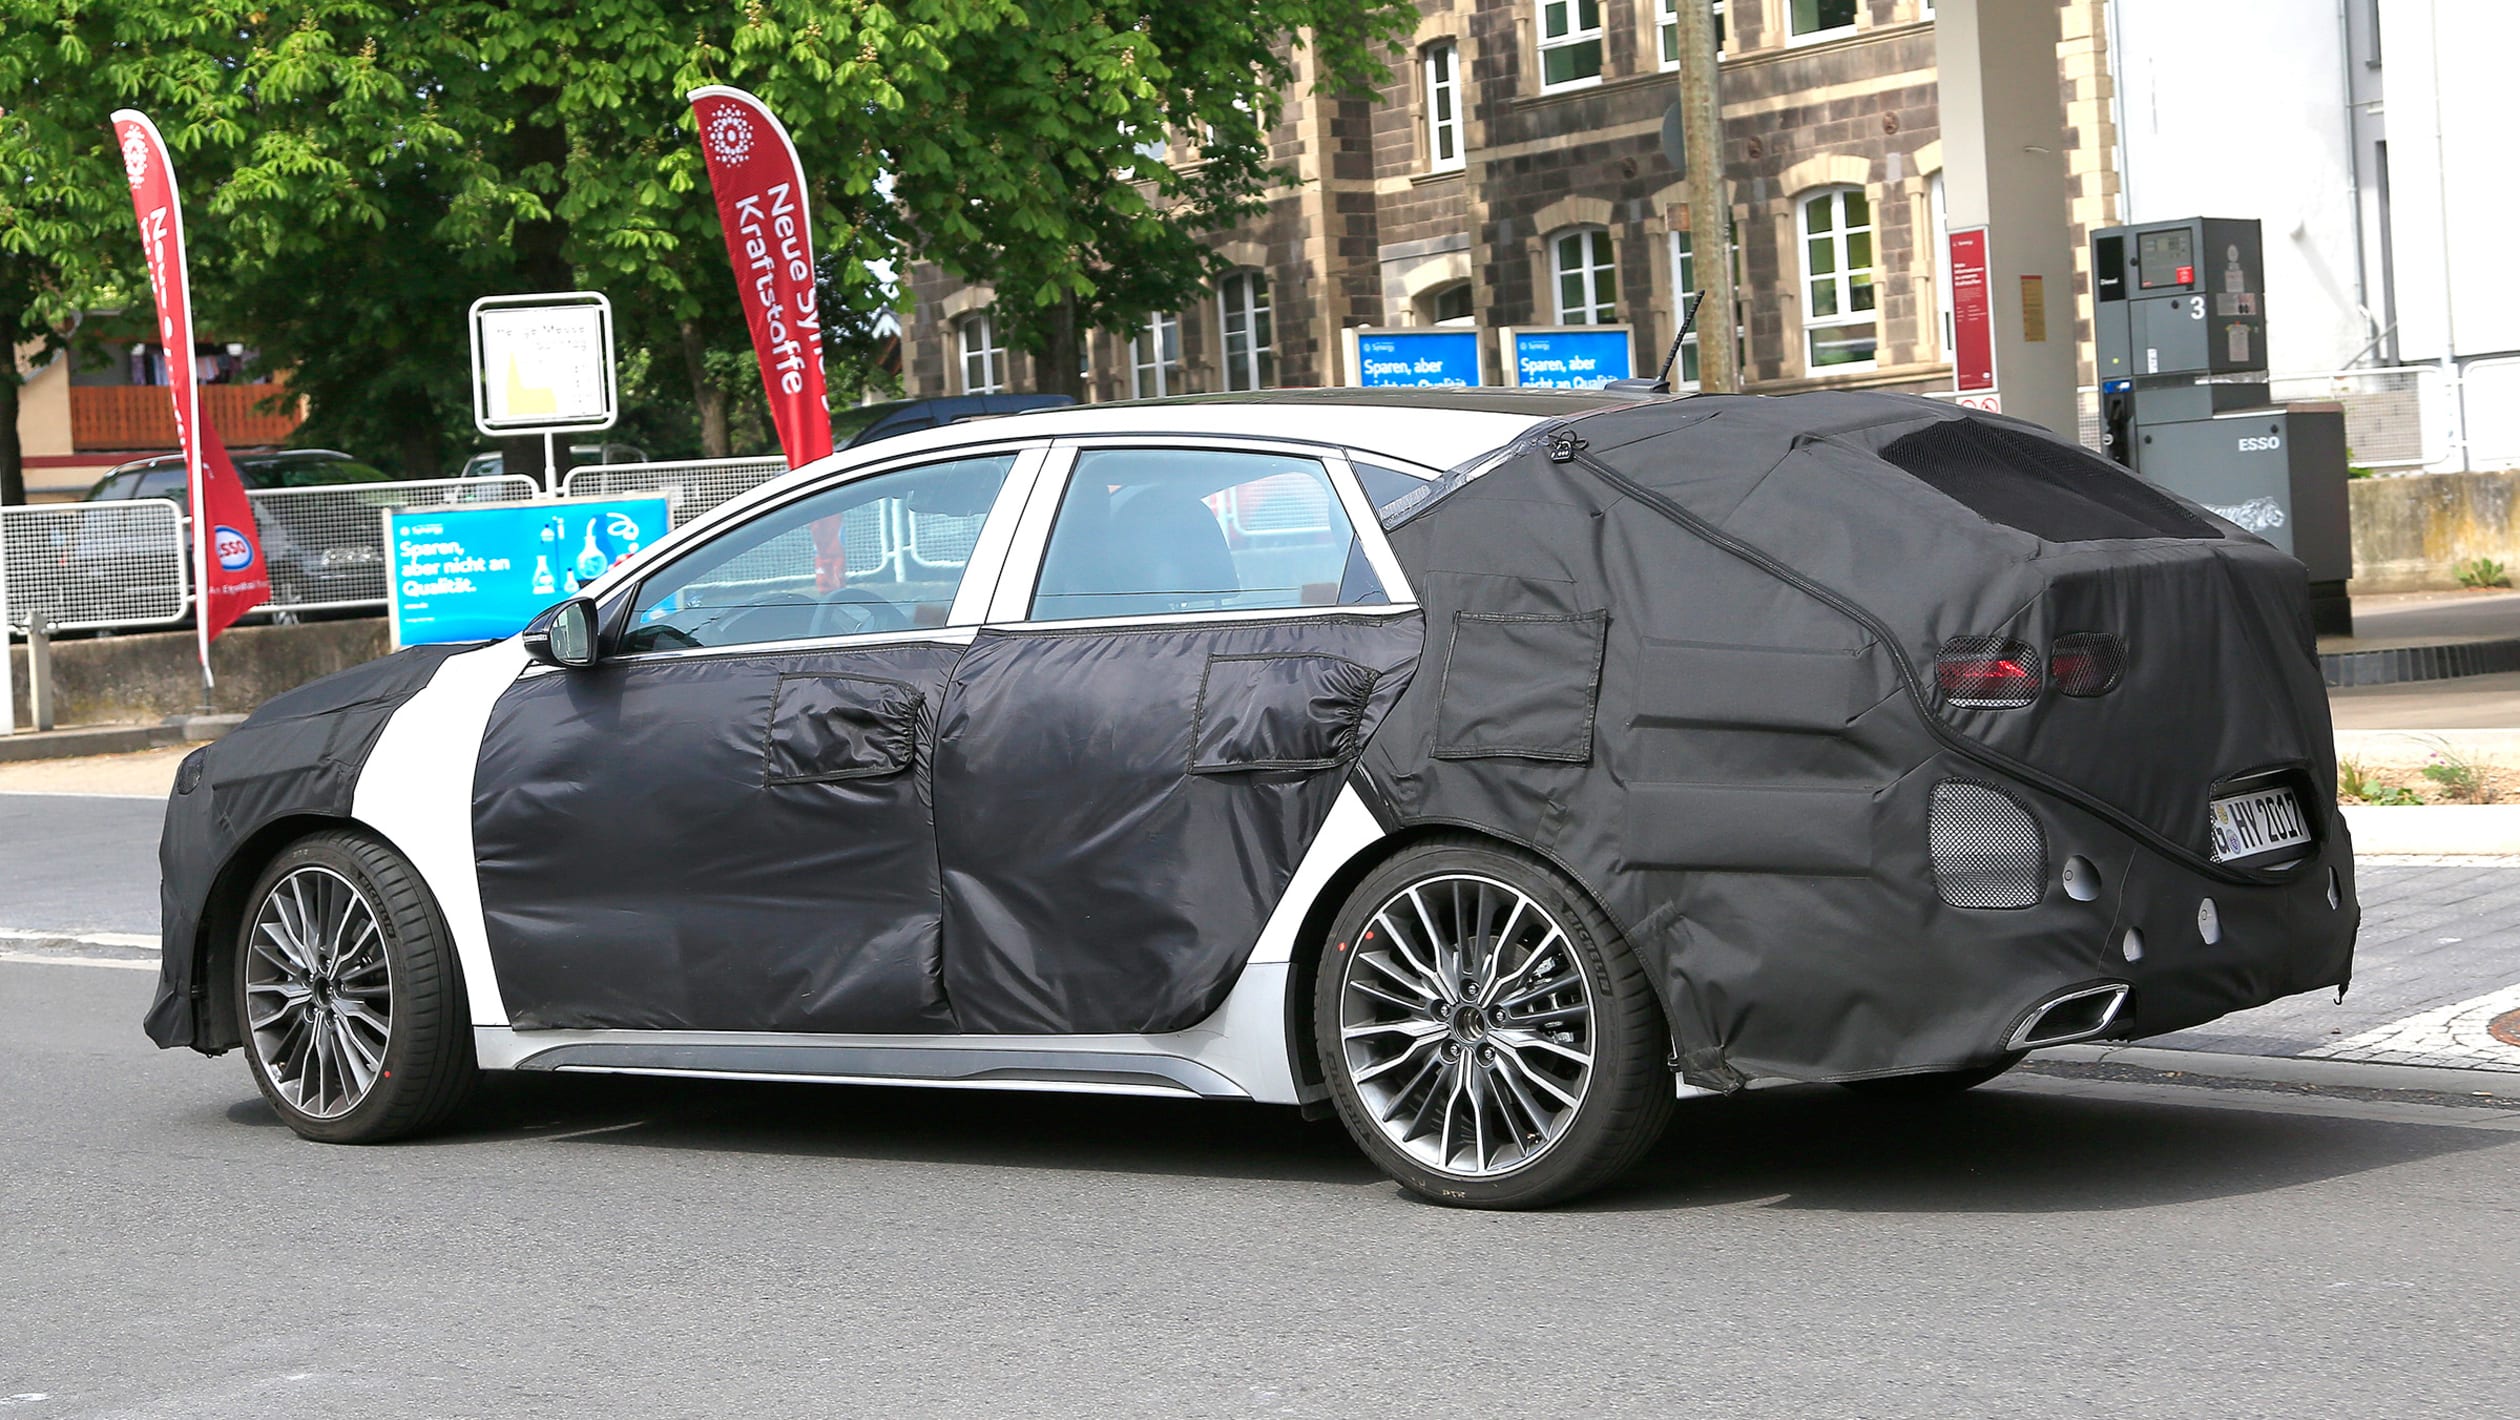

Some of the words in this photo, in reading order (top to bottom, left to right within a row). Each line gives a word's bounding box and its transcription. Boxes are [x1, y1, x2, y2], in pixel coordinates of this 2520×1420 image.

[767, 182, 808, 281] Neue
[735, 194, 806, 395] Kraftstoffe
[2190, 296, 2206, 320] 3
[1364, 359, 1412, 378] Sparen,
[1414, 357, 1443, 373] aber
[1521, 357, 1567, 376] Sparen,
[1569, 355, 1596, 370] aber
[2238, 436, 2280, 451] ESSO
[219, 540, 247, 558] SSO
[400, 541, 464, 561] Sparen,
[402, 560, 440, 577] aber
[443, 556, 486, 574] nicht
[489, 558, 510, 571] an
[2228, 800, 2263, 849] HY
[2255, 792, 2304, 843] 2017
